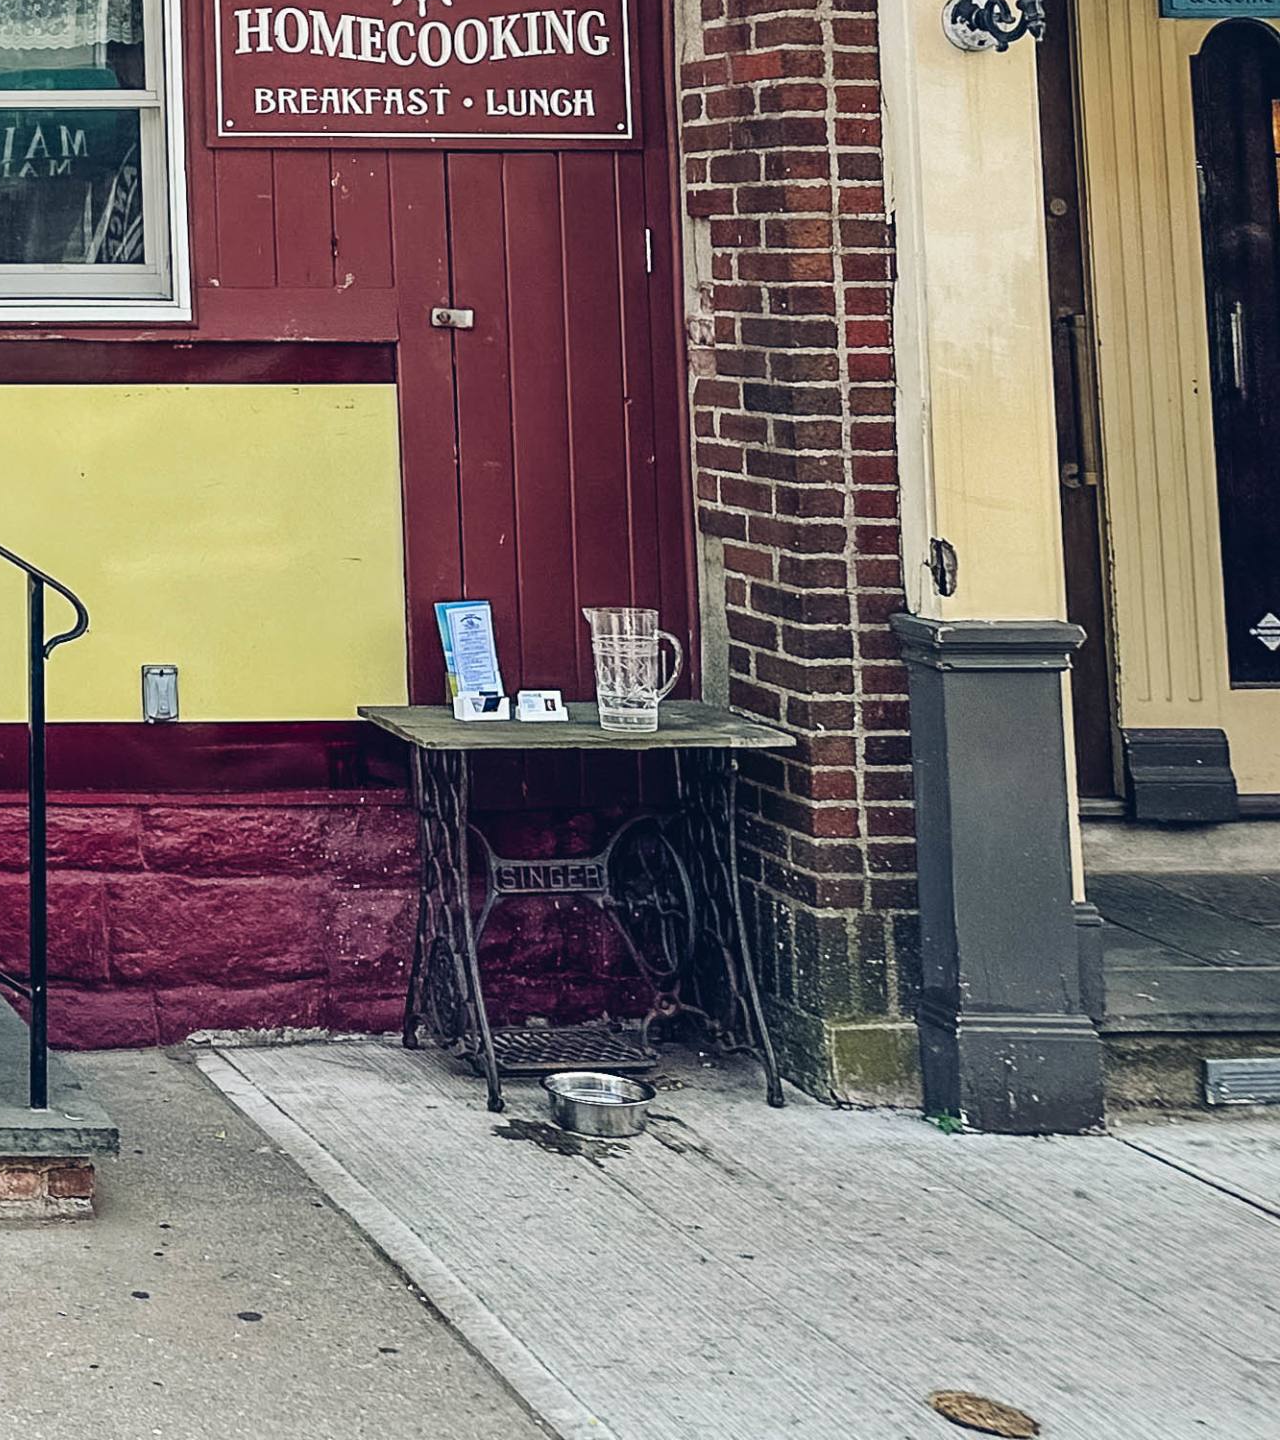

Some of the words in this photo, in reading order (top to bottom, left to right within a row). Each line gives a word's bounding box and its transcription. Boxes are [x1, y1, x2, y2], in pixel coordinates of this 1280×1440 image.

[234, 7, 610, 66] HOMECOOKING
[254, 87, 450, 116] BREAKFAST
[486, 89, 595, 117] LUNCH
[501, 865, 601, 888] SINGER
